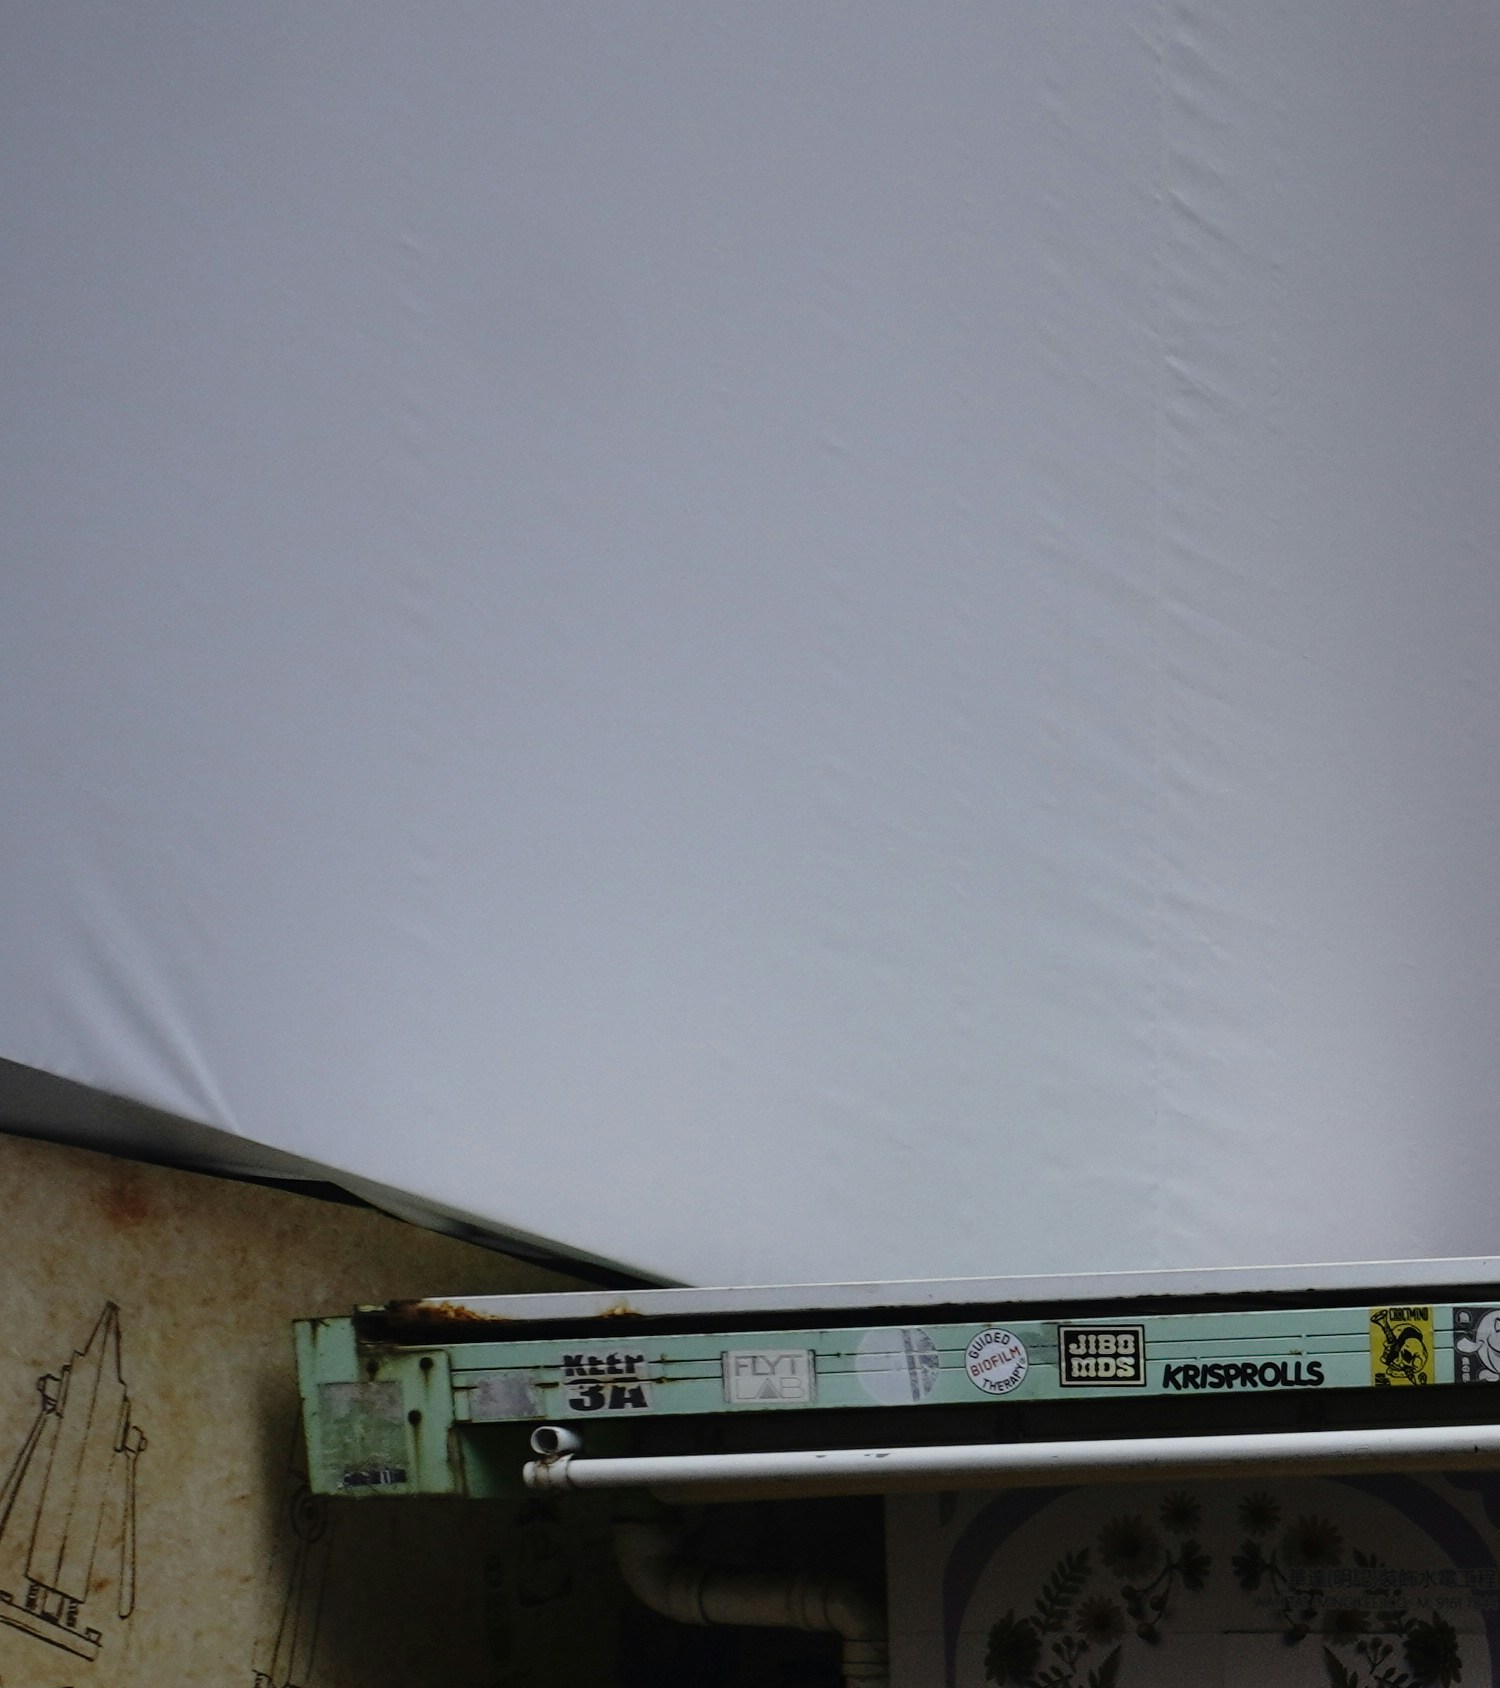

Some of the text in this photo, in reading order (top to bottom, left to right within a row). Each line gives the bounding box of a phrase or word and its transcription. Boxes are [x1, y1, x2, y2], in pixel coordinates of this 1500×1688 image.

[968, 1330, 1012, 1361] GUIDED
[562, 1350, 646, 1377] KEEP
[734, 1354, 804, 1377] FLYT
[969, 1345, 1022, 1378] BIOFILM
[1070, 1356, 1136, 1379] MDS
[1162, 1361, 1325, 1390] KRISPROLLS
[568, 1378, 649, 1412] 3A
